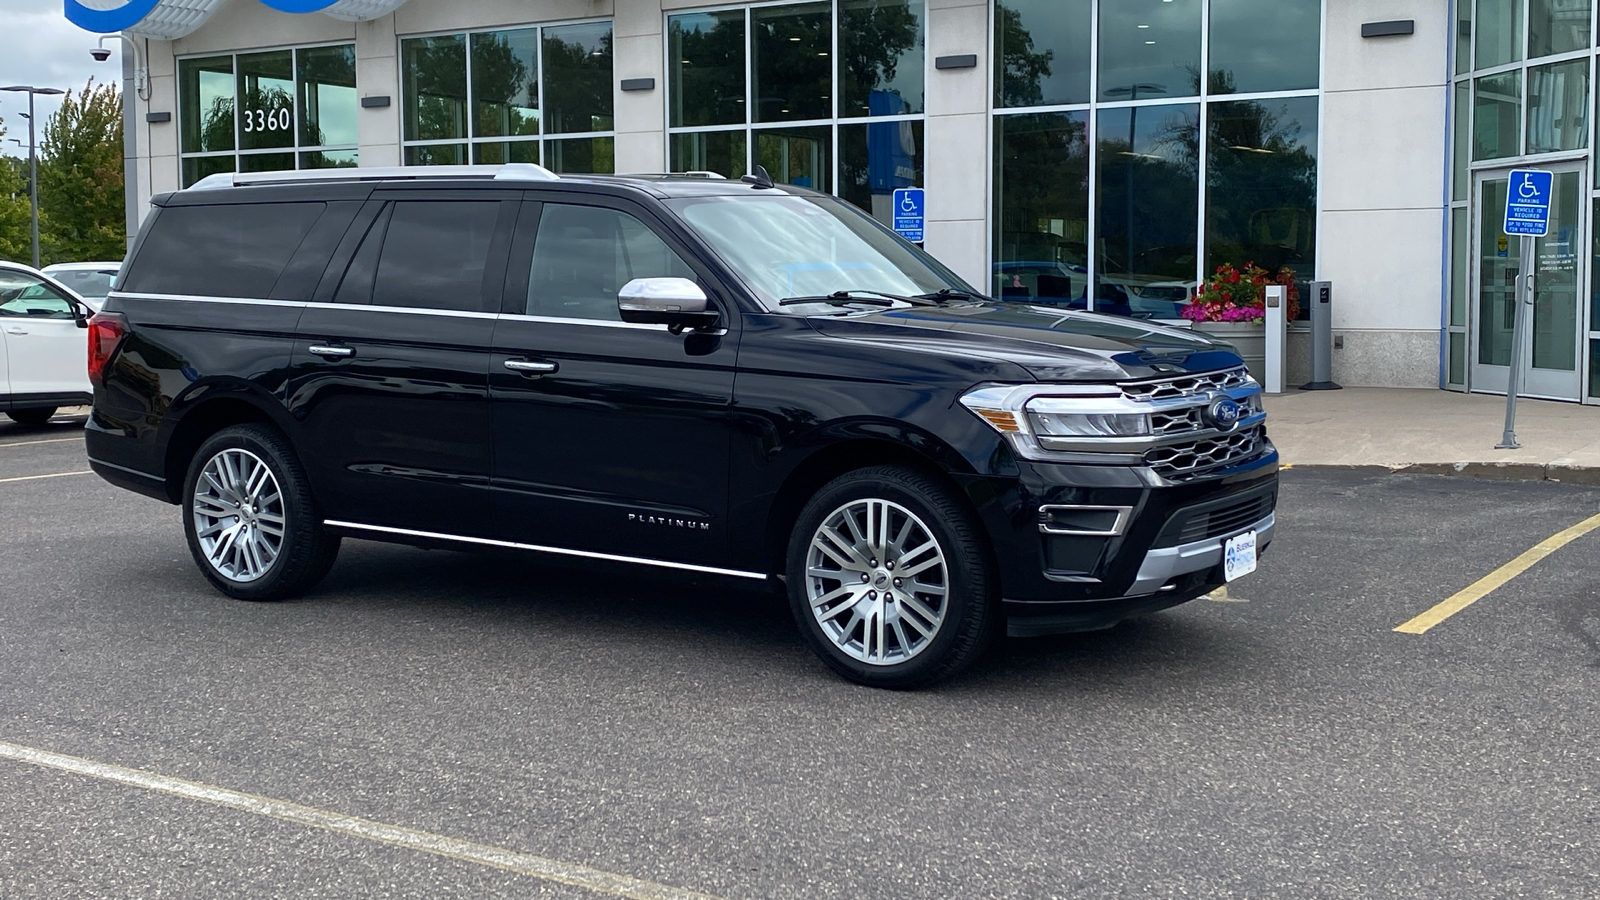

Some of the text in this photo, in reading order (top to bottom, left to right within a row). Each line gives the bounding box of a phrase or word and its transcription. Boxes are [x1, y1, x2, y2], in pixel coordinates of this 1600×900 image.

[244, 107, 290, 133] 3360
[1221, 405, 1236, 420] Ford
[628, 513, 709, 530] PLATINUM
